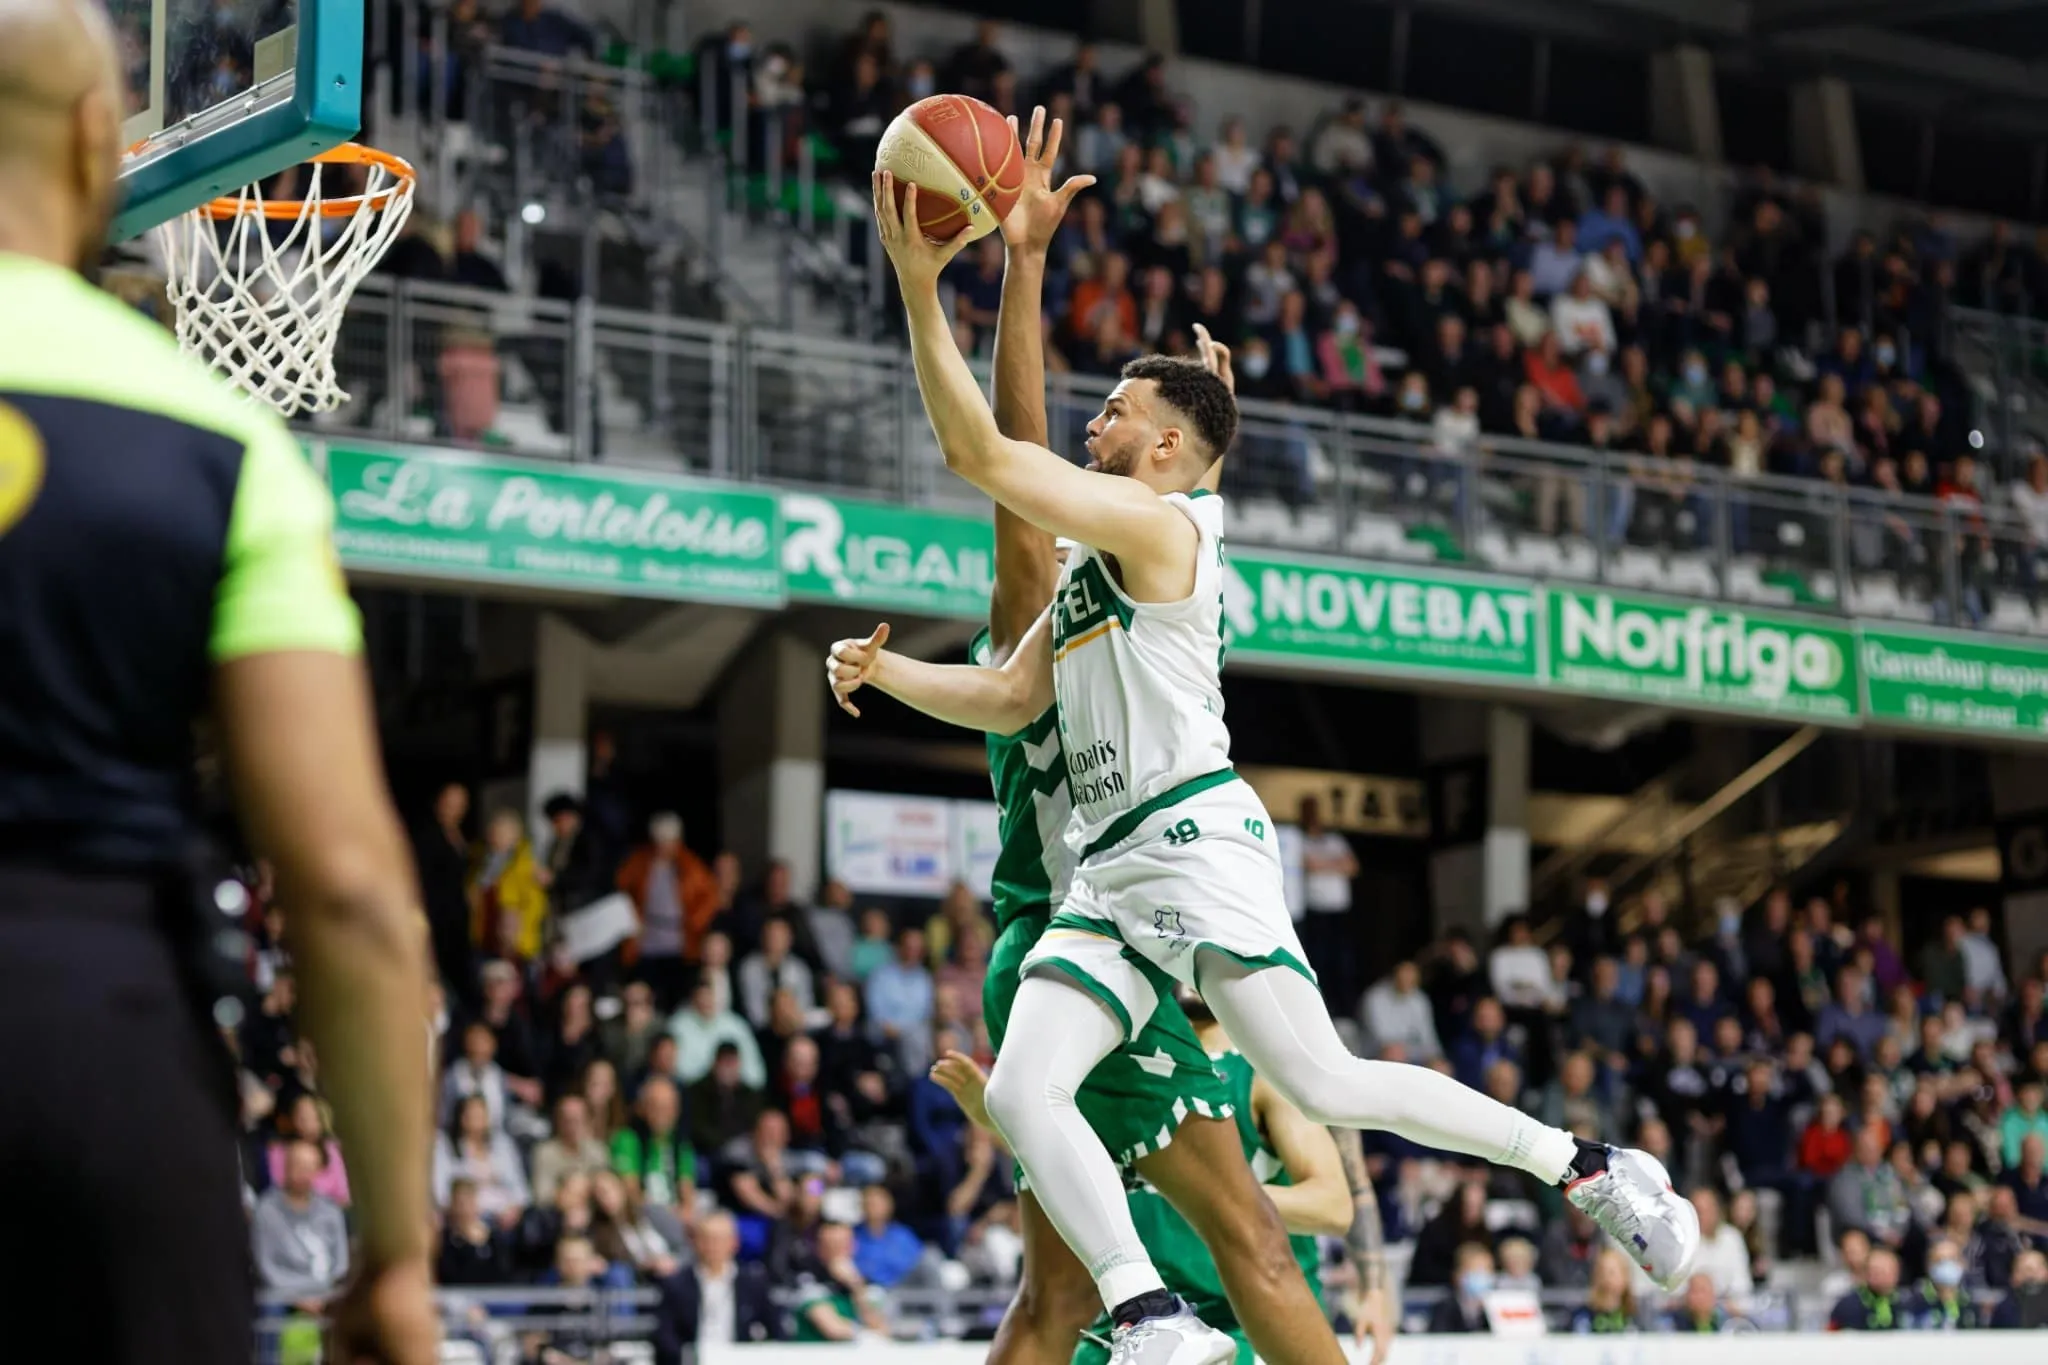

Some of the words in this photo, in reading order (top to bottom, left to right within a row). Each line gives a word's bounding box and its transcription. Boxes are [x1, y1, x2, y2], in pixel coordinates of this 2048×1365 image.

[340, 461, 476, 531] La
[1261, 568, 1529, 647] NOVEBAT
[1560, 593, 1842, 702] Norfrigo
